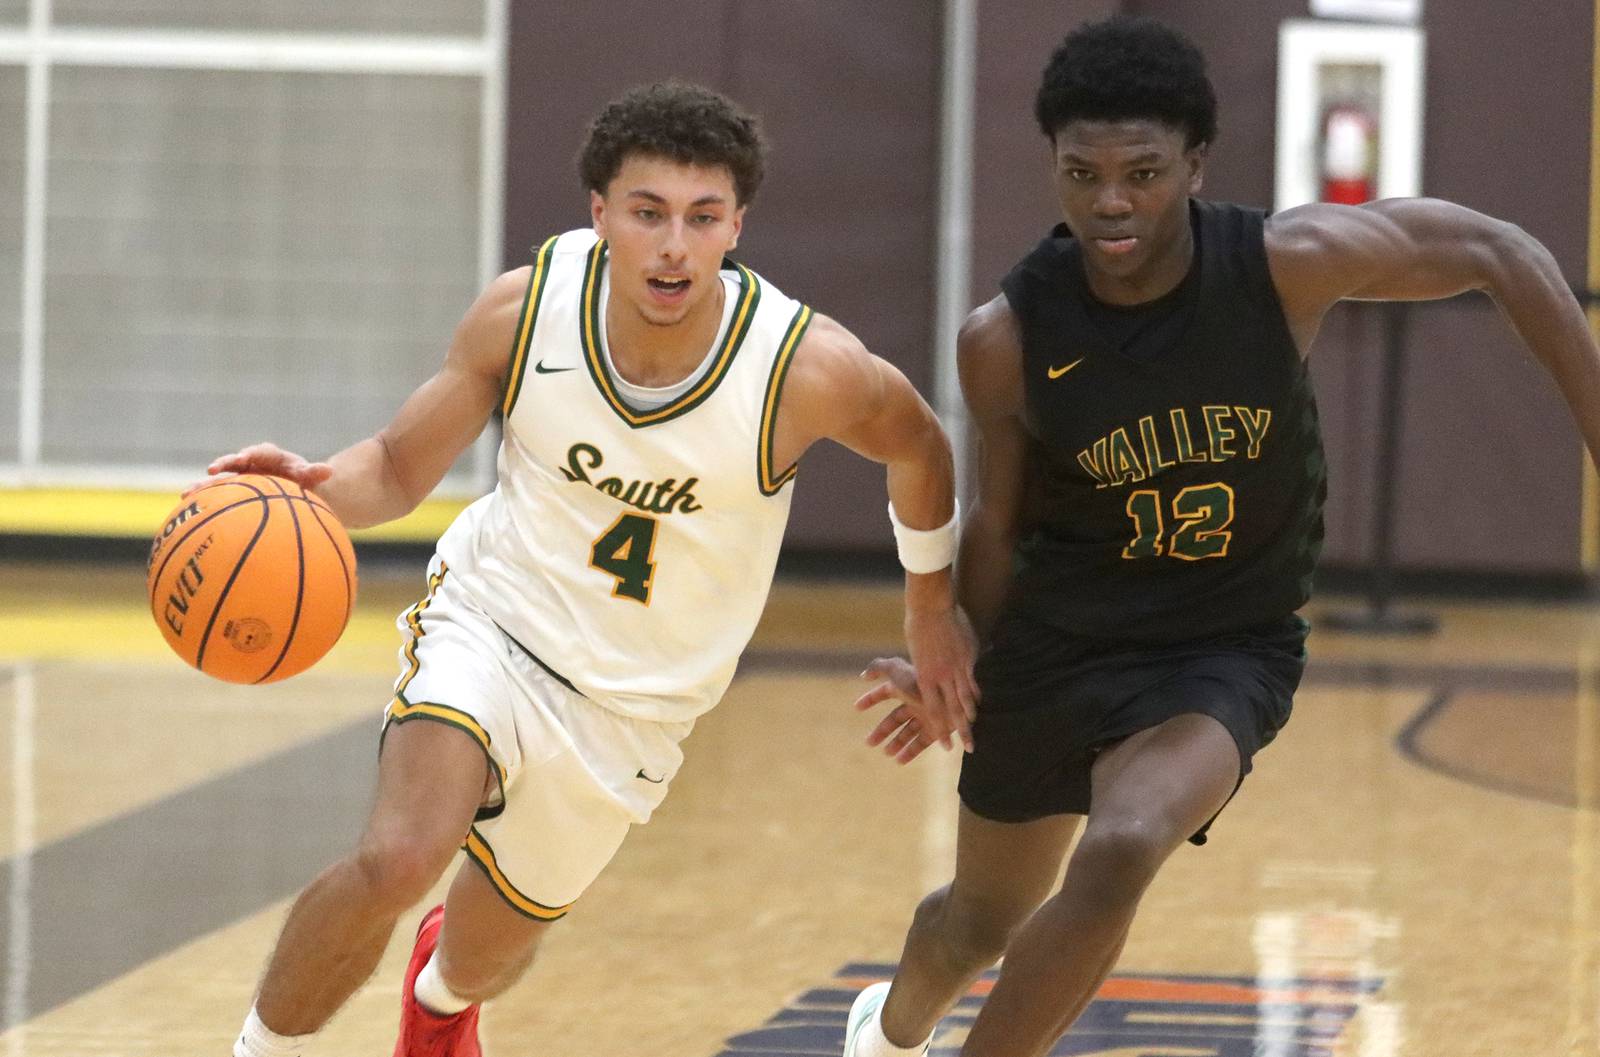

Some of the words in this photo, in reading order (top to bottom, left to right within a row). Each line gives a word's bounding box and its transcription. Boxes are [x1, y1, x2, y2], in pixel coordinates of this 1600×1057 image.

[558, 443, 703, 514] South
[1076, 405, 1271, 489] VALLEY
[587, 510, 660, 608] 4
[1121, 482, 1235, 561] 12
